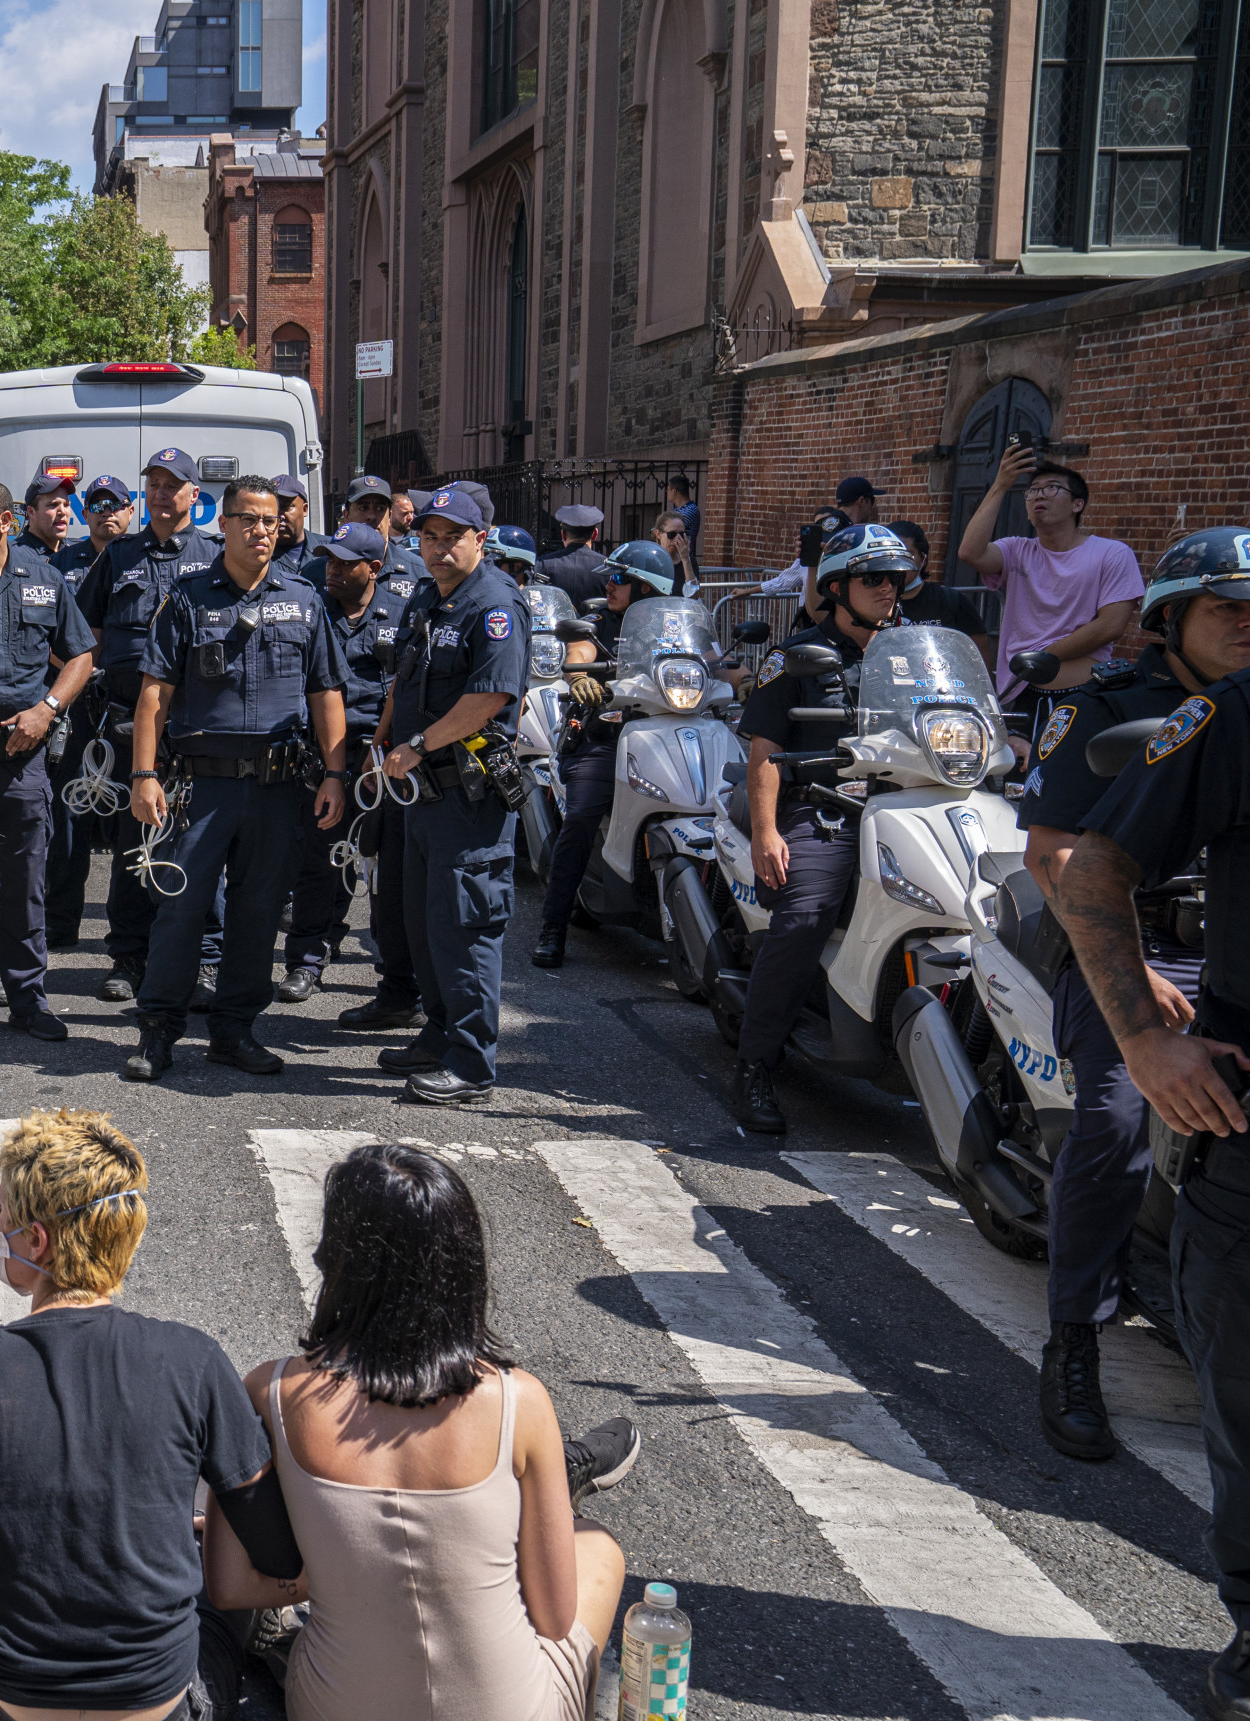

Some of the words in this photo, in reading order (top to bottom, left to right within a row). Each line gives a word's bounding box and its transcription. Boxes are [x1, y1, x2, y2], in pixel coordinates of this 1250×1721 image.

[23, 588, 56, 598] POLICE
[390, 582, 415, 593] POLIC
[262, 604, 300, 614] POLICE
[378, 628, 396, 639] POL
[1157, 743, 1173, 757] NEW
[1175, 726, 1196, 744] YORK
[730, 878, 757, 906] NYPD
[1008, 1036, 1058, 1082] NYPD
